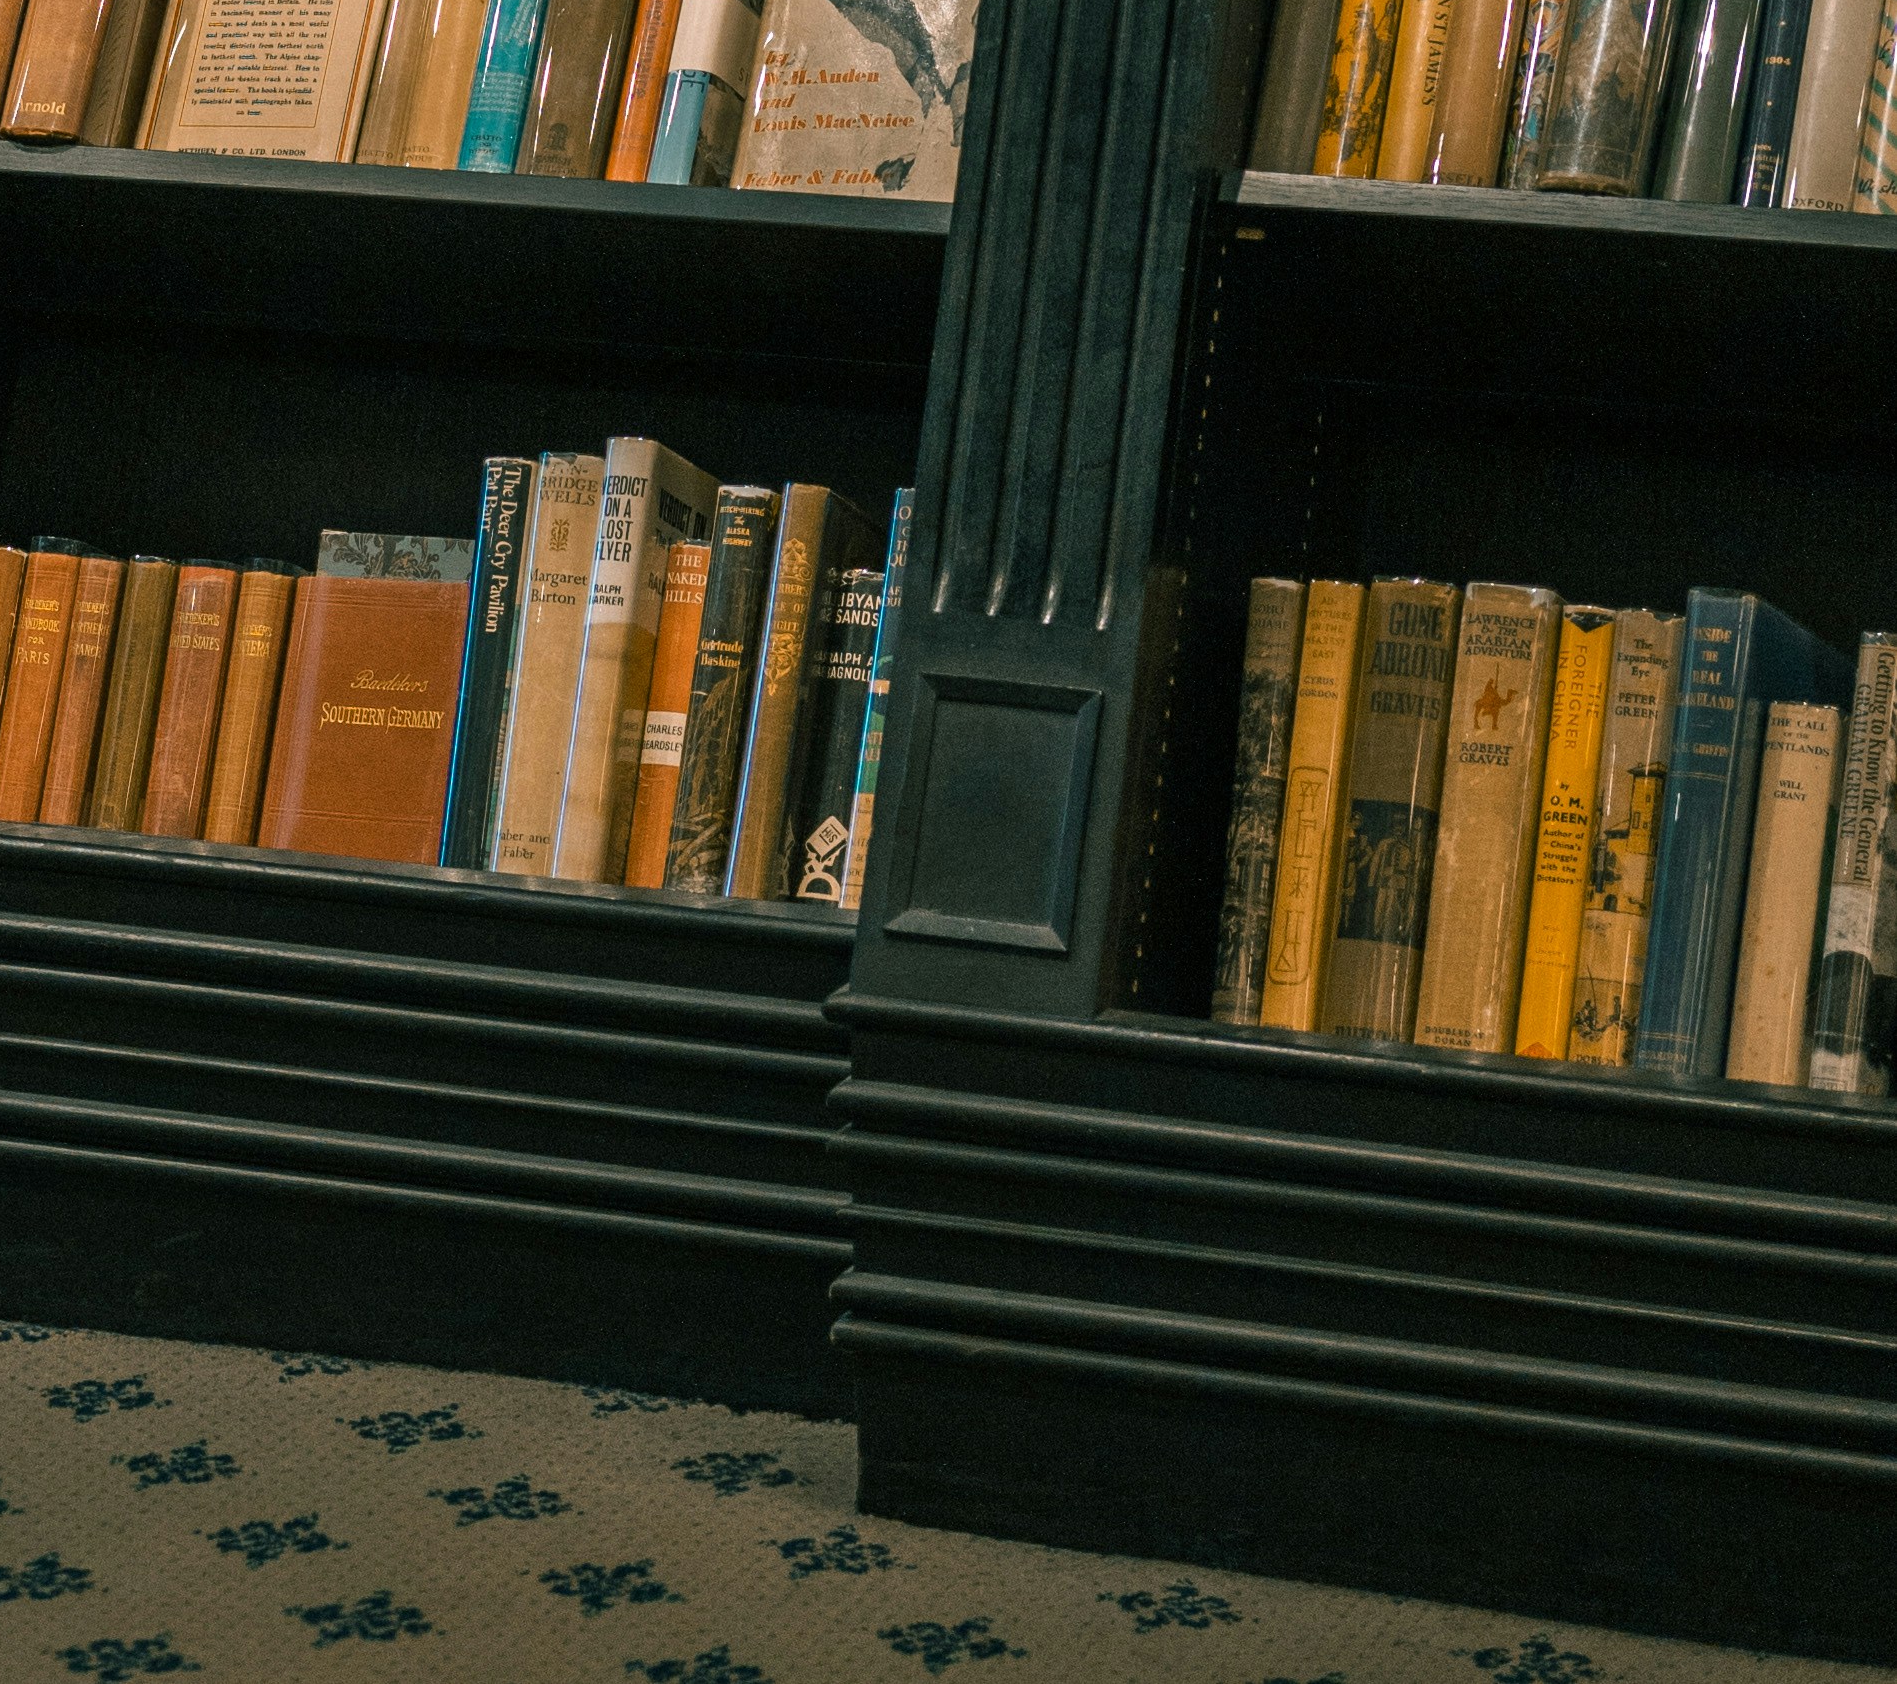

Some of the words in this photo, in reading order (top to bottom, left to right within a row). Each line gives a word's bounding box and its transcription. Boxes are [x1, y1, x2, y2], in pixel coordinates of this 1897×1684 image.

[1792, 197, 1844, 211] OXFORD
[665, 589, 702, 605] HILLS
[1617, 693, 1656, 707] PETER
[320, 702, 385, 730] SOUTHERN
[387, 706, 444, 730] GERMANY
[1460, 742, 1512, 757] ROBERT
[1543, 810, 1588, 825] GREEN
